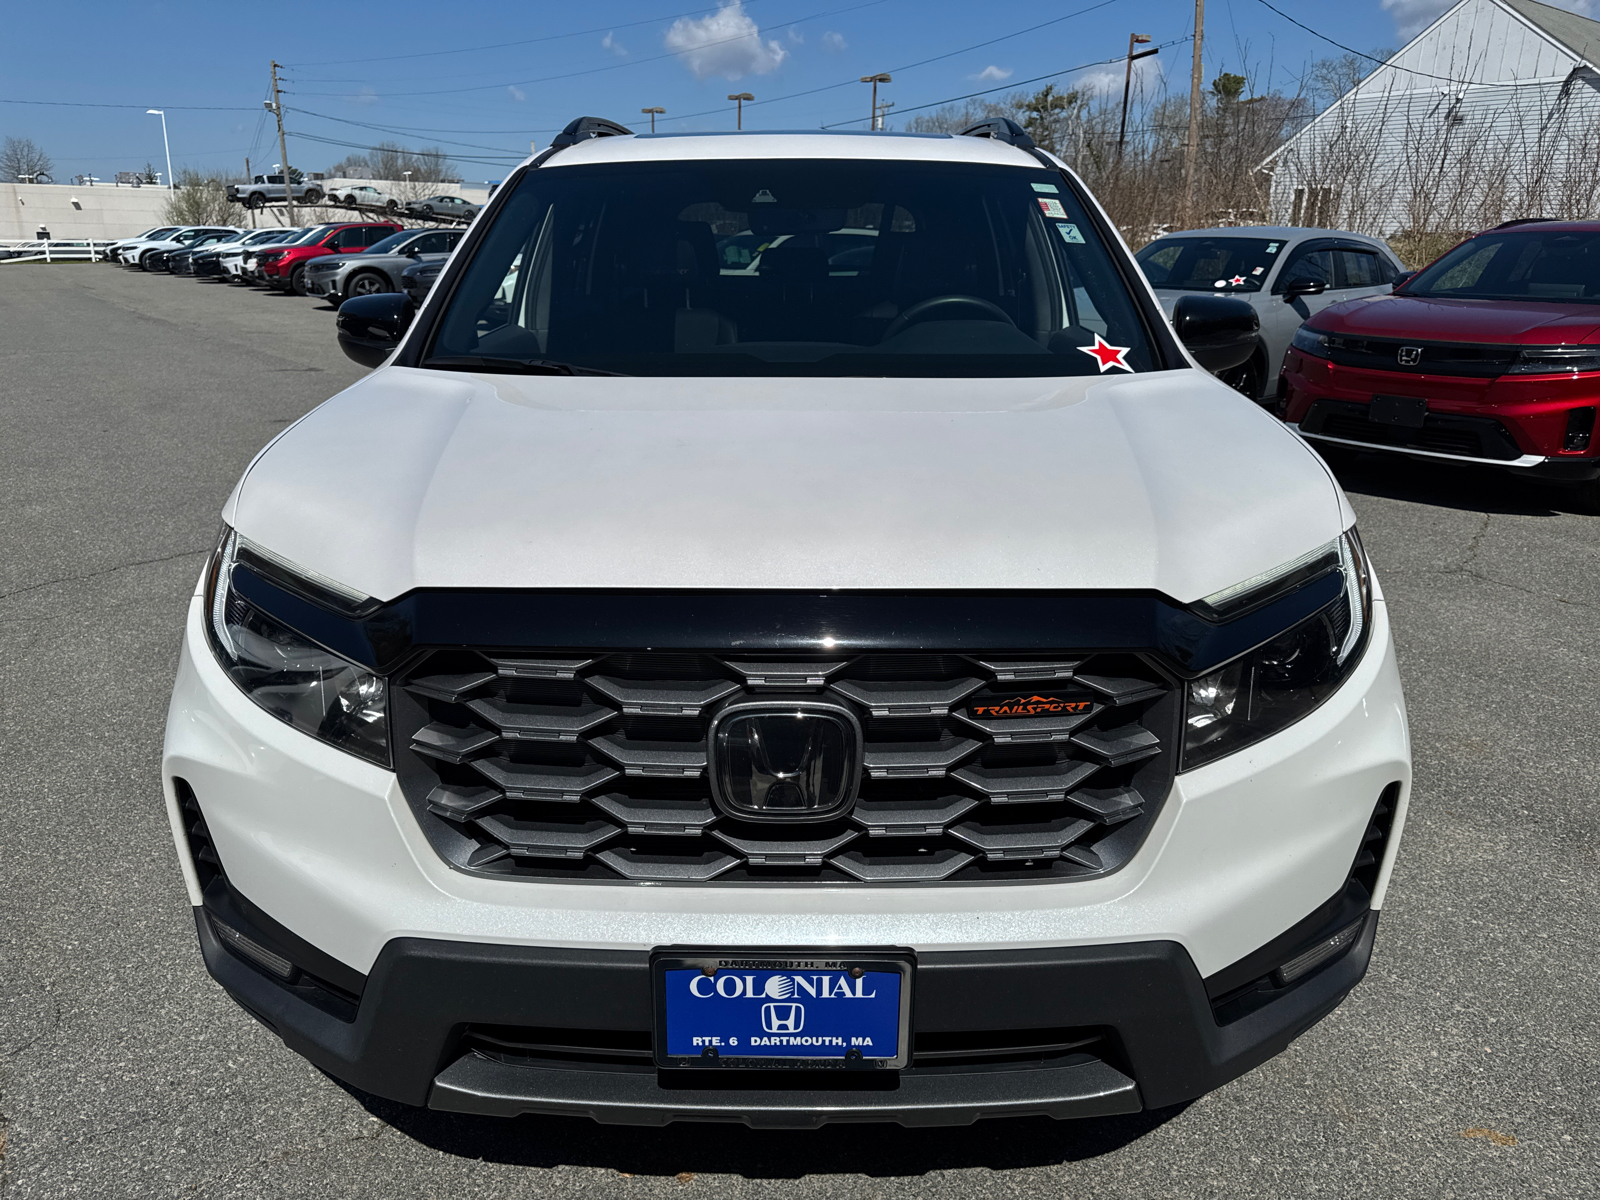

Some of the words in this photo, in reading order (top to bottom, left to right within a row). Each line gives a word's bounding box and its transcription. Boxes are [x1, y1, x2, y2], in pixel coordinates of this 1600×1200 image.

[973, 701, 1091, 716] TRAILSPORT
[824, 961, 848, 970] MA
[689, 974, 877, 1000] COLONIAL
[692, 1036, 725, 1047] RTE.
[728, 1036, 739, 1047] 6
[750, 1036, 847, 1048] DARTMOUTH,
[851, 1036, 873, 1047] MA
